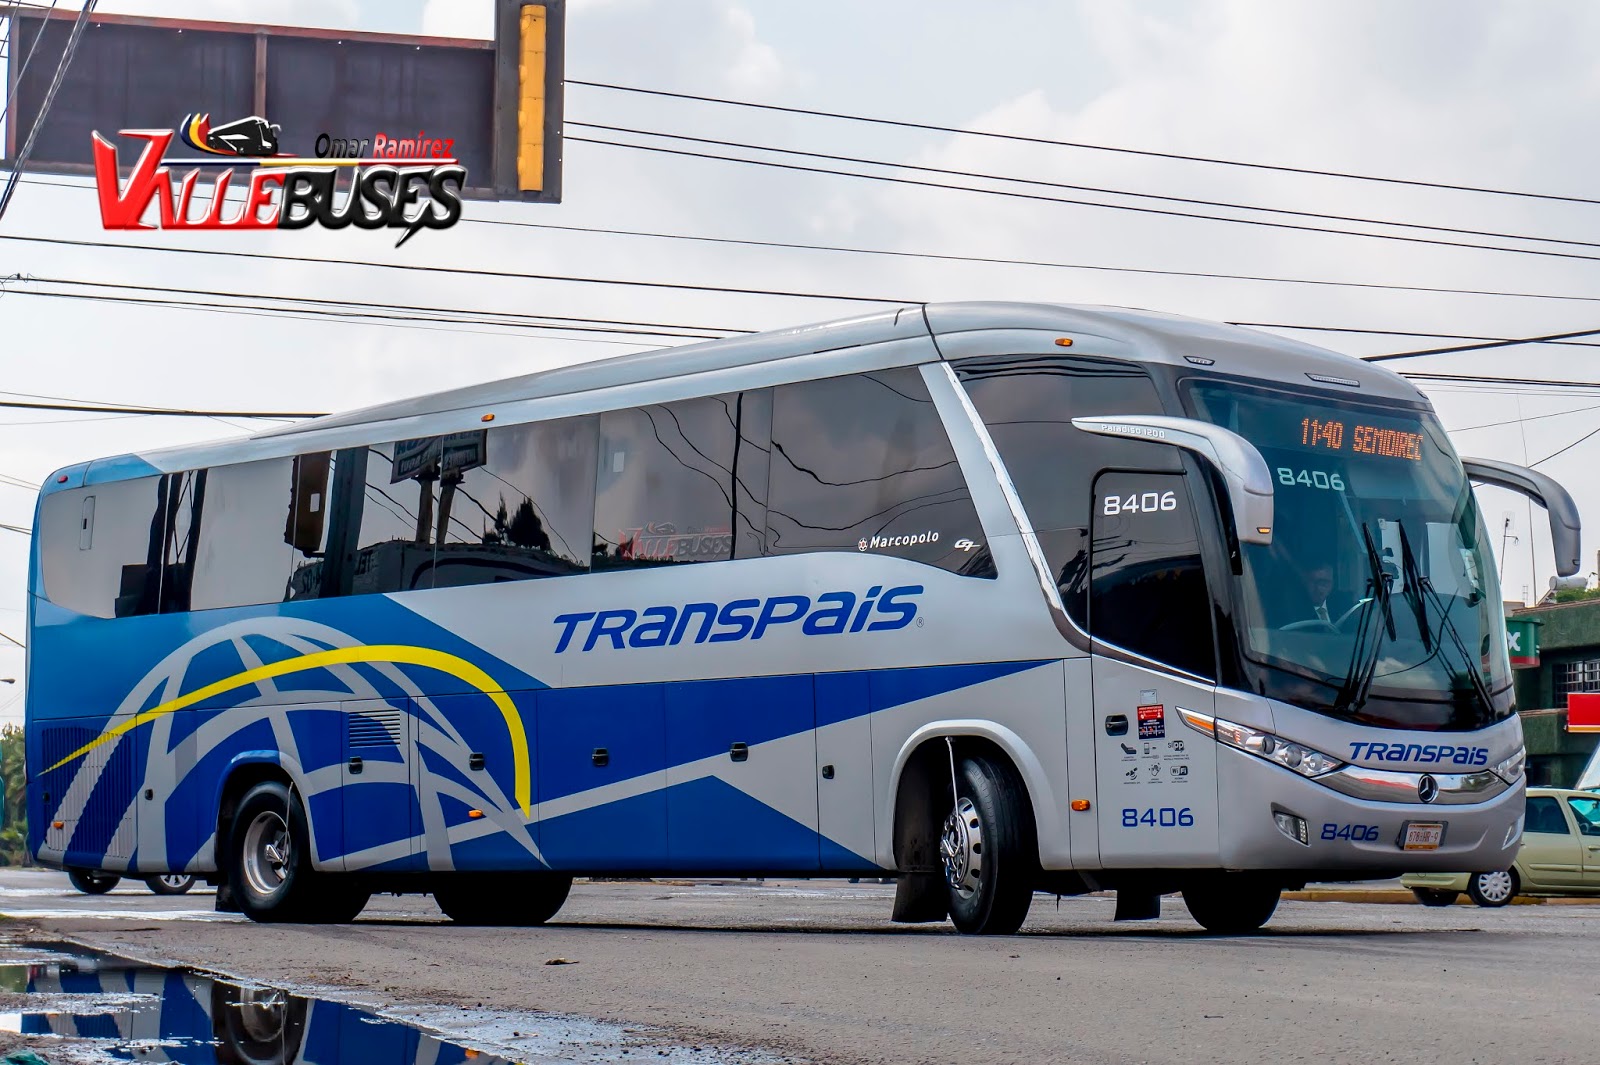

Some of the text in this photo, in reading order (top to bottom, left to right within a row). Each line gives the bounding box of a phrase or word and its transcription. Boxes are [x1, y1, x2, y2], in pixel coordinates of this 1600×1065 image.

[1101, 424, 1165, 439] Paradiso 1200
[1301, 418, 1424, 460] 11:40 SEMIDIREC
[1277, 467, 1345, 491] 8406
[1103, 490, 1177, 516] 8406
[869, 531, 939, 549] Marcopolo
[1122, 807, 1194, 827] 8406
[1320, 823, 1379, 842] 8406
